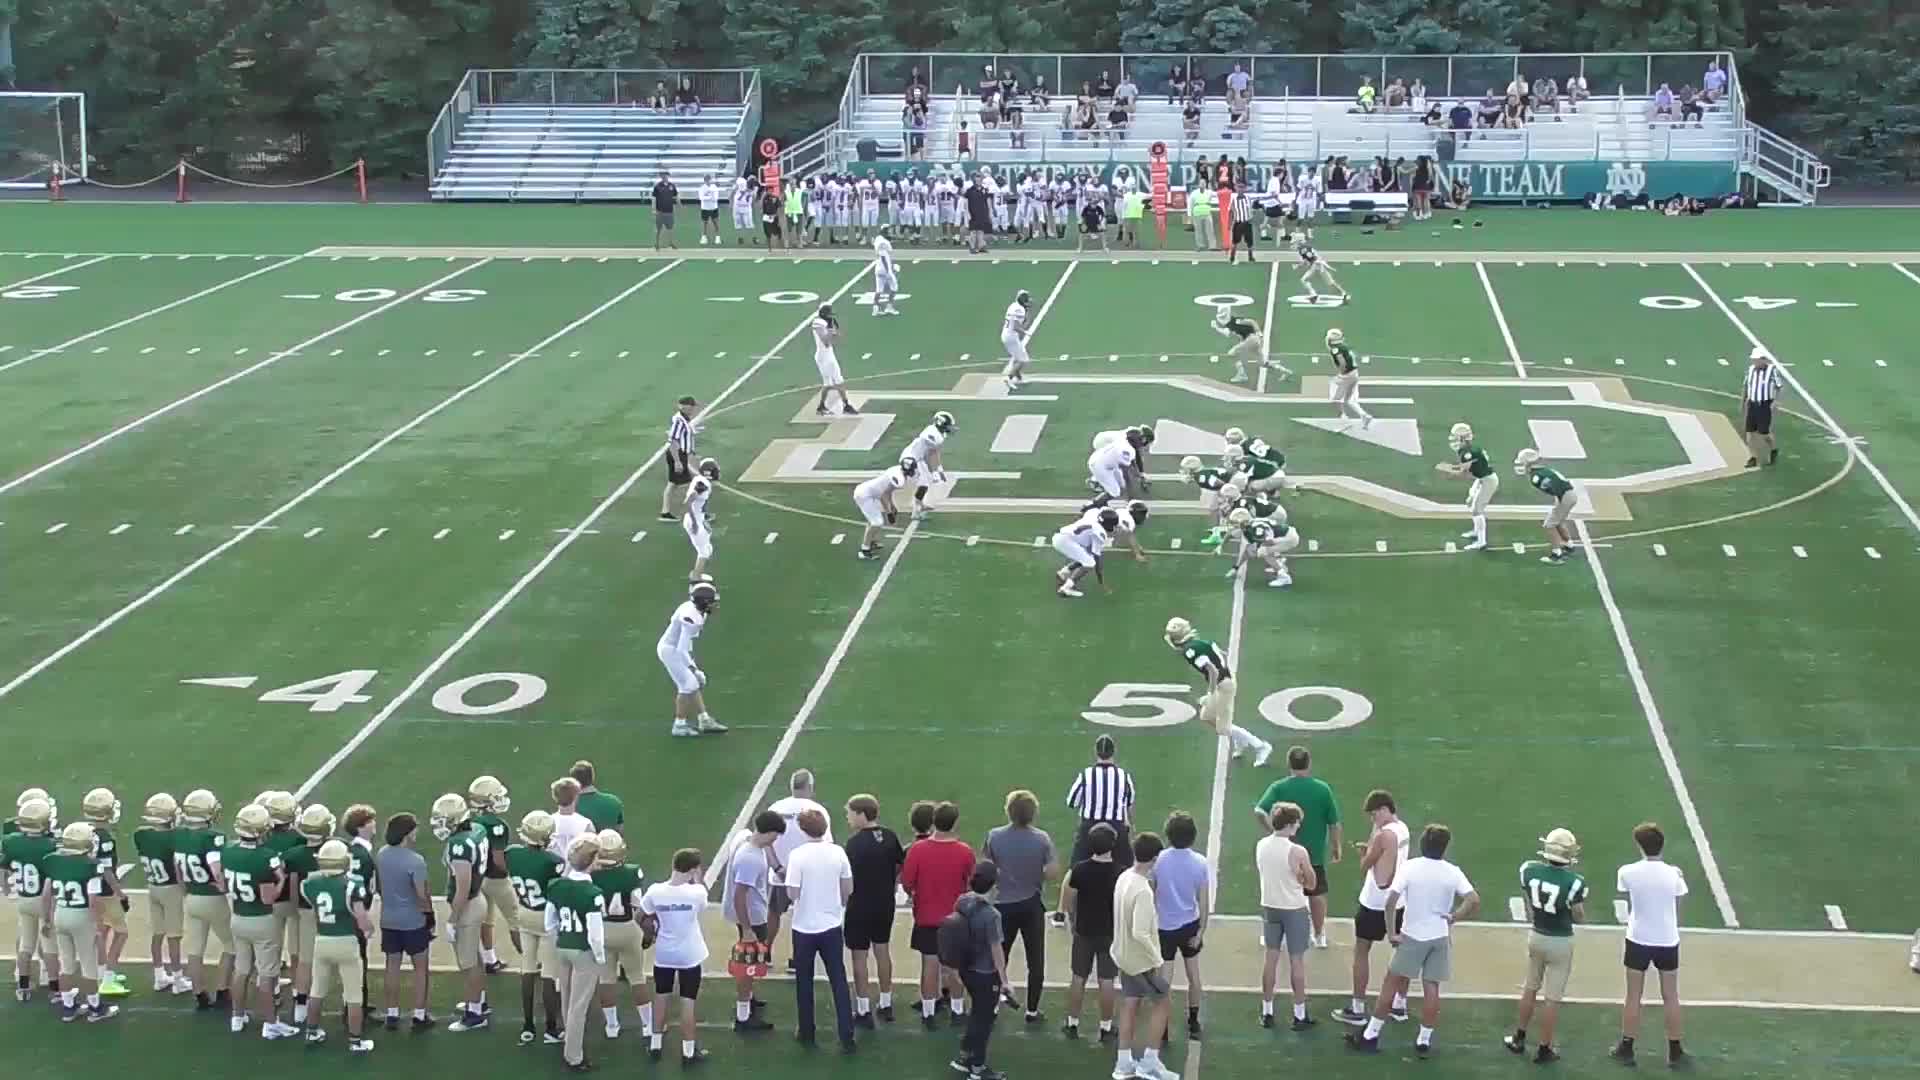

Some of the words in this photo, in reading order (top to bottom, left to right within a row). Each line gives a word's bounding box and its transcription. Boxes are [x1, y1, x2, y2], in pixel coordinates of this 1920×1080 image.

[1480, 164, 1565, 195] TEAM
[8, 861, 39, 894] 28
[173, 851, 209, 883] 76
[224, 868, 256, 902] 75
[1529, 878, 1560, 914] 17
[316, 892, 336, 924] 2
